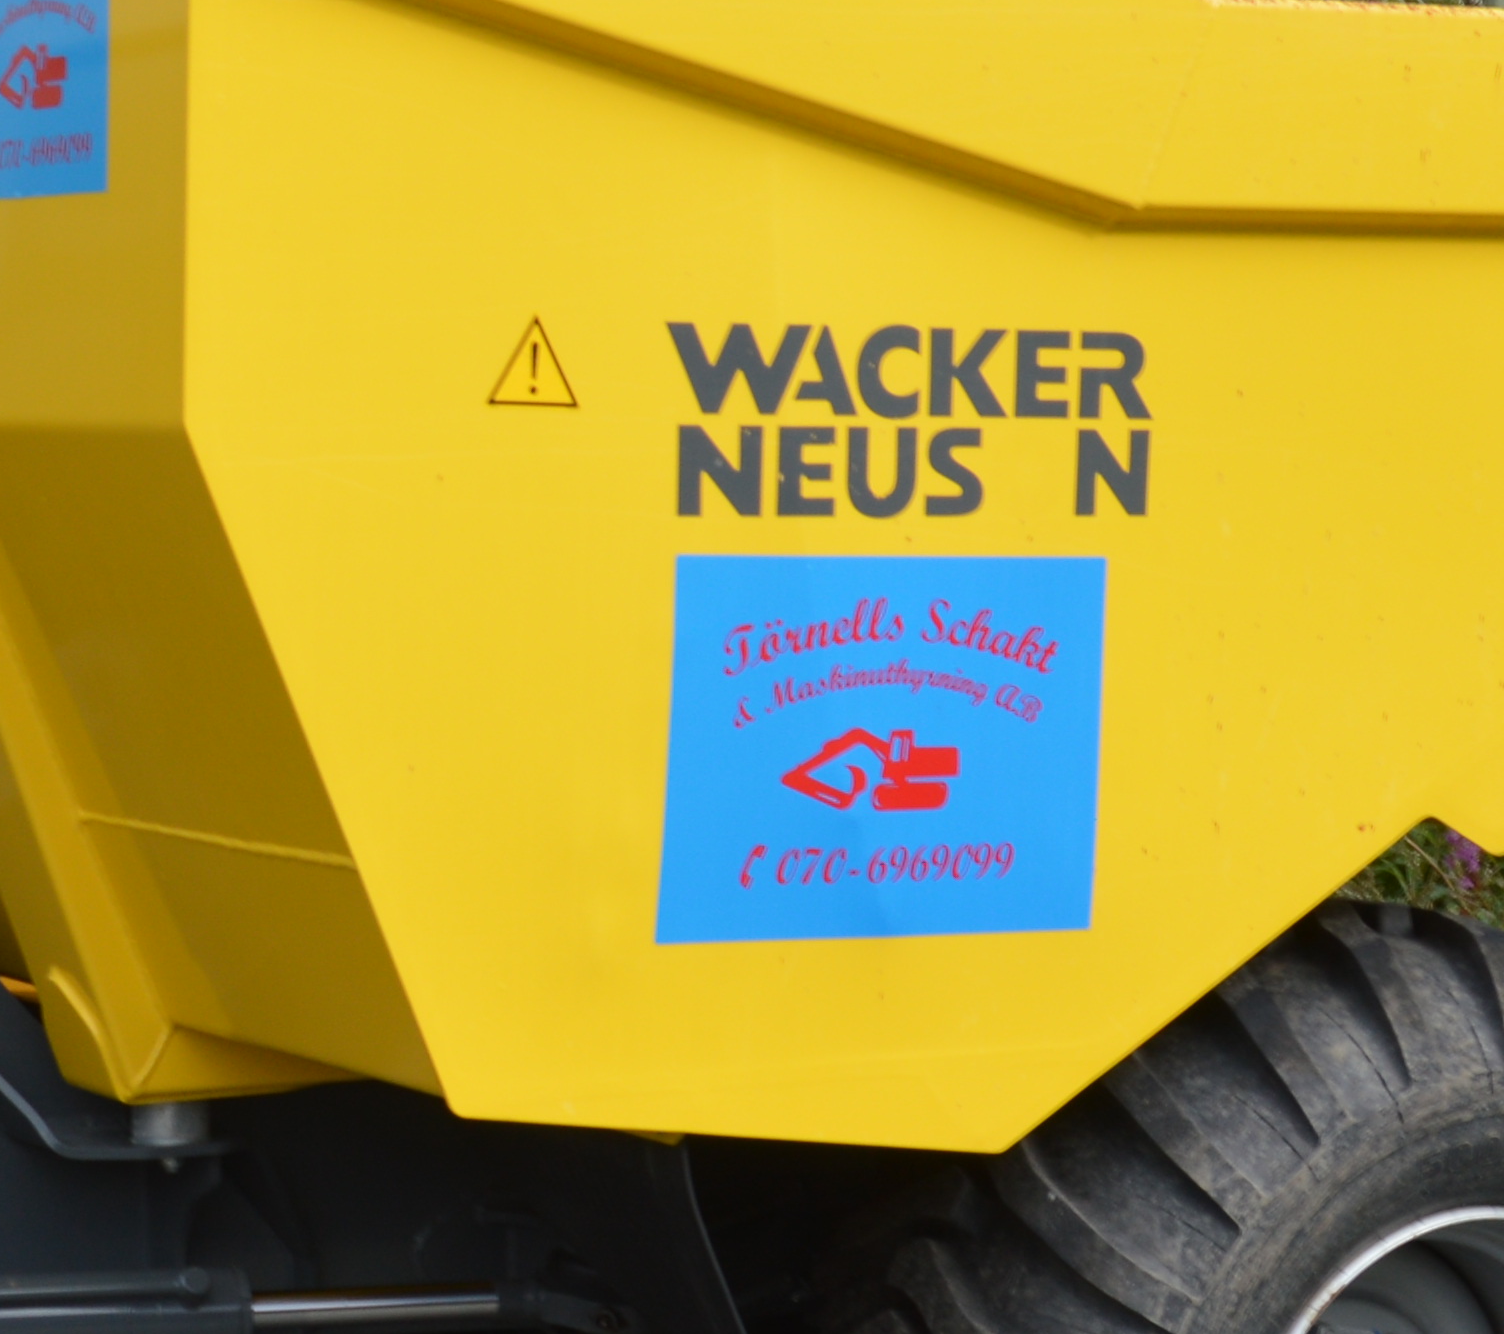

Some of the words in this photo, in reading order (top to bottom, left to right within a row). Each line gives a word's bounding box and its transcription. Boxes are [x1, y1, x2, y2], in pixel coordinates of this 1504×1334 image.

[666, 321, 1152, 420] WACKER
[723, 597, 904, 676] Törnells
[921, 598, 1060, 674] Schakt
[775, 841, 1016, 887] 070-6969099
